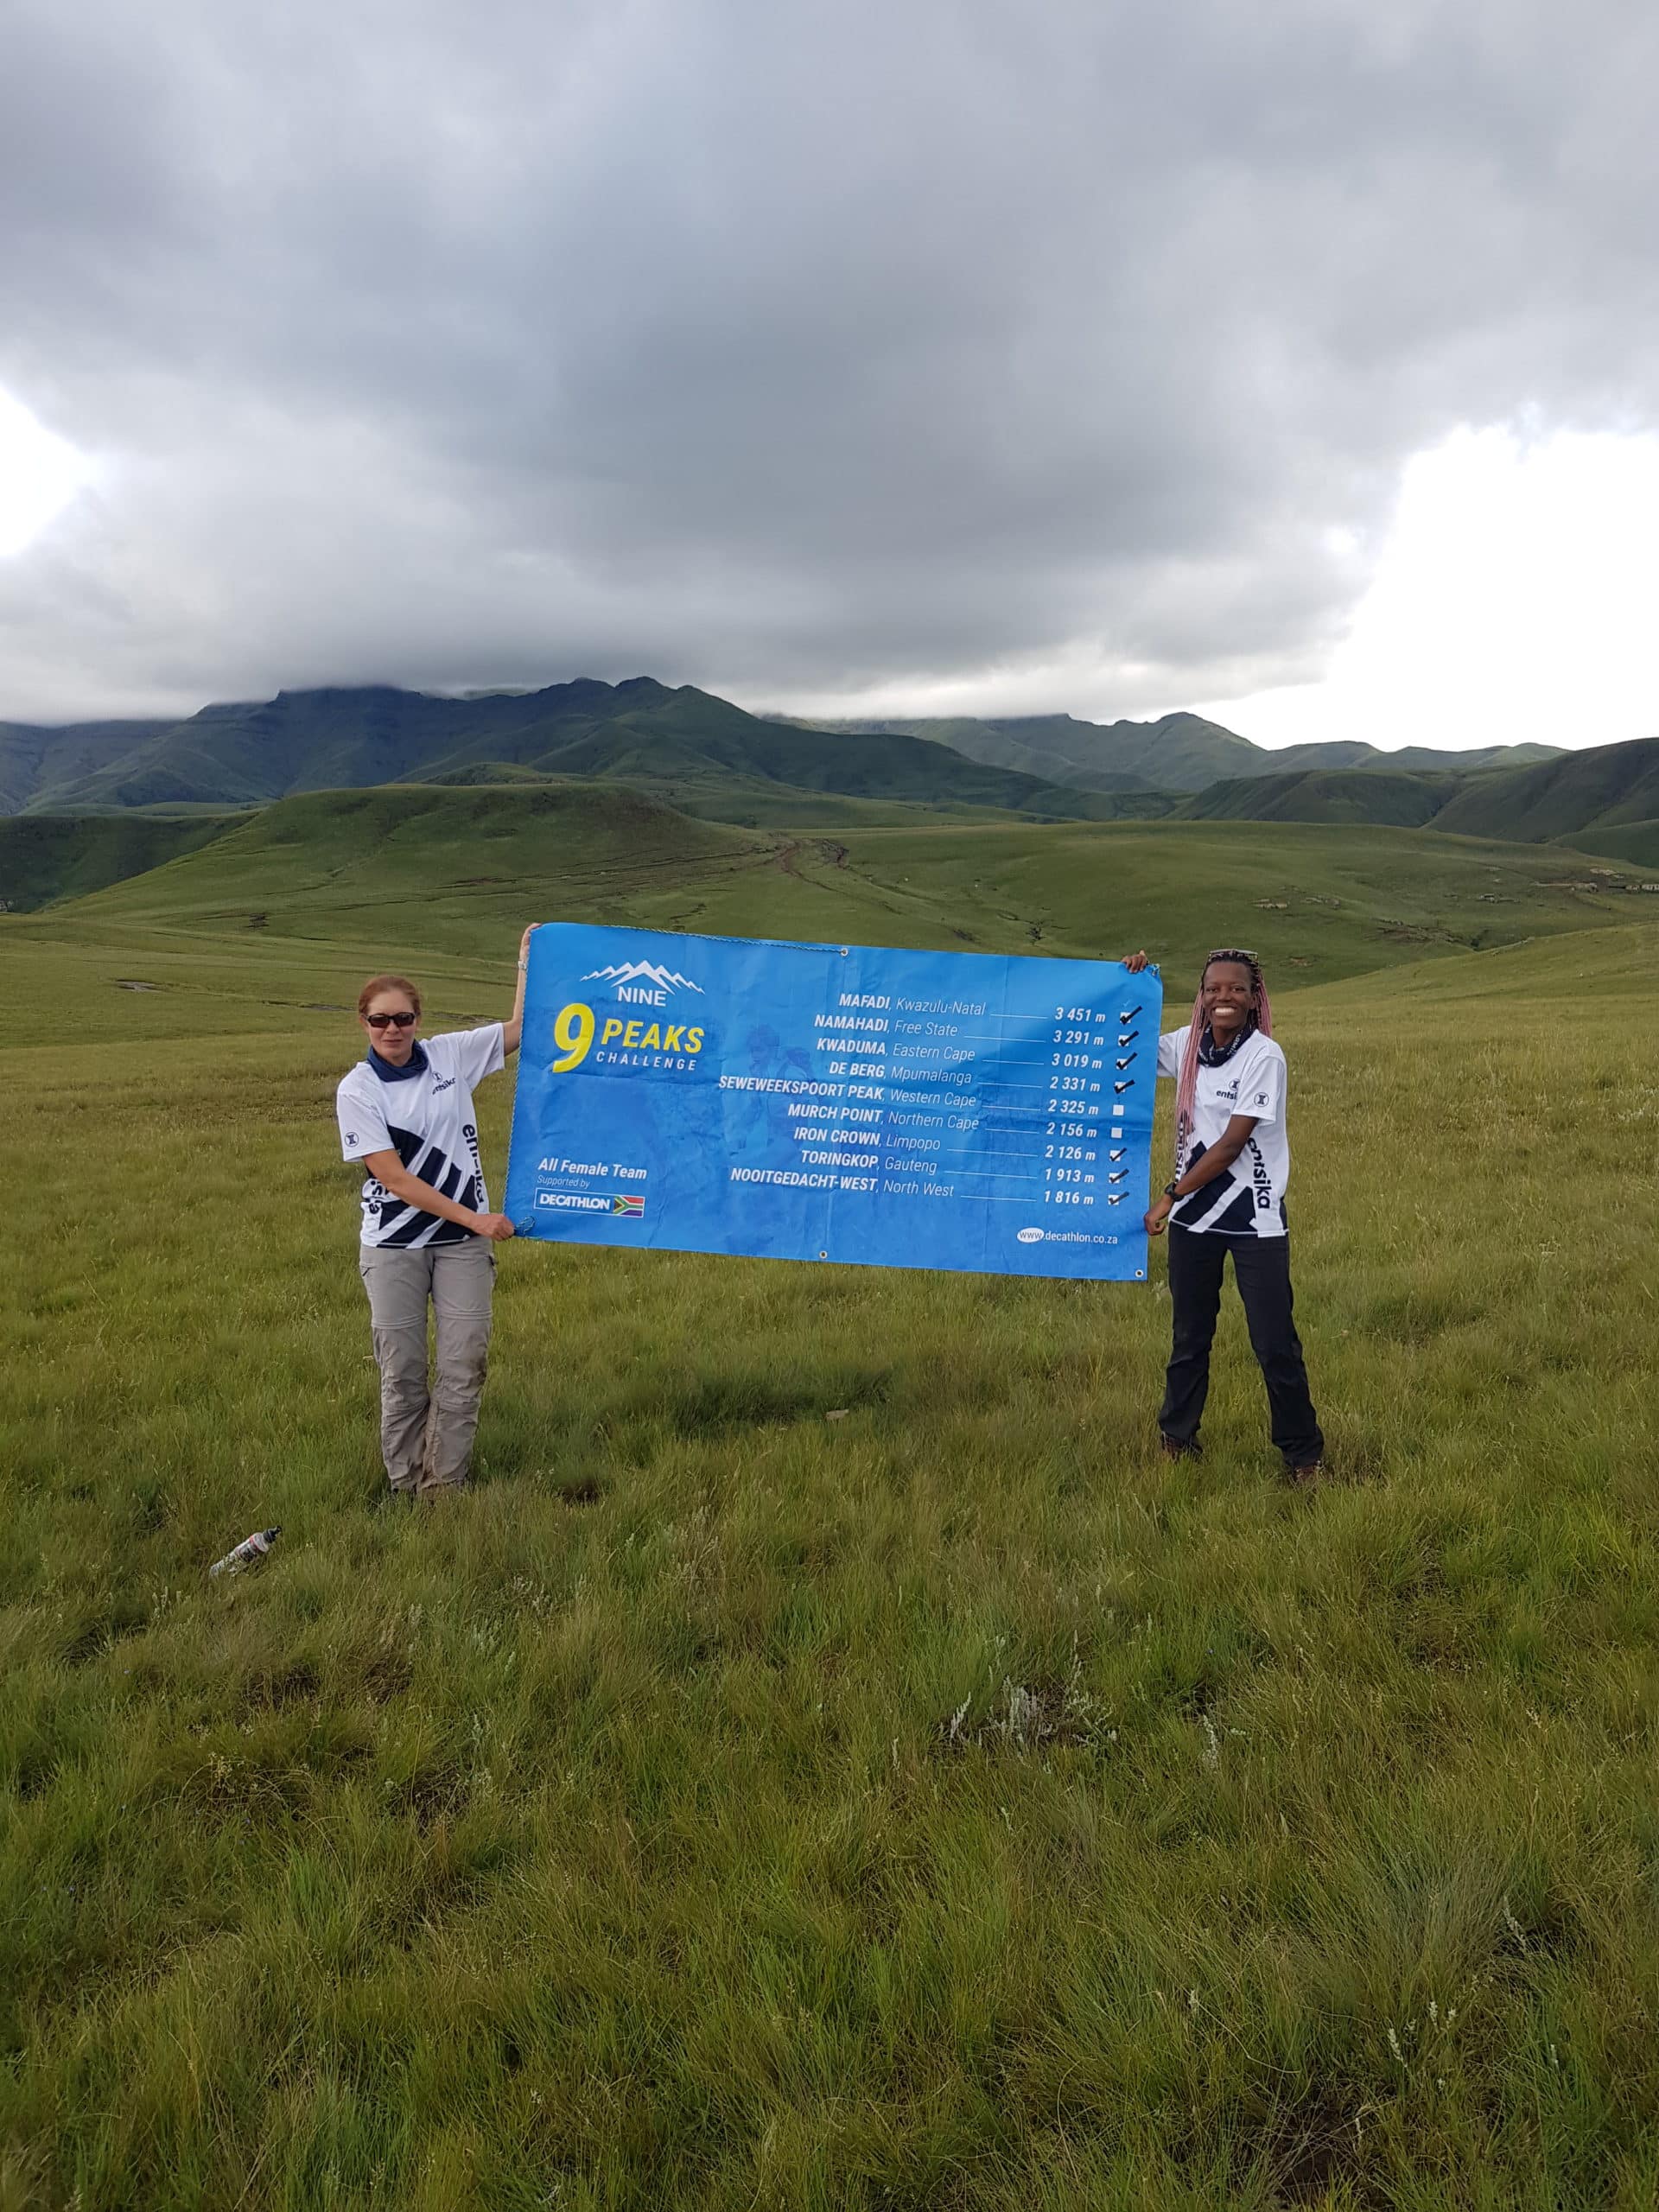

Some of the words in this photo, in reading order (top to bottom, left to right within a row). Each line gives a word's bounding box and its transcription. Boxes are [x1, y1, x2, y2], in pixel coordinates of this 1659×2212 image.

[617, 986, 667, 1007] NINE
[896, 997, 987, 1016] Kwazulu-Natal
[1054, 1007, 1064, 1020] 3
[1067, 1007, 1091, 1022] 451
[1095, 1014, 1106, 1023] m
[552, 1002, 595, 1073] 9
[601, 1018, 705, 1054] PEAKS
[894, 1020, 922, 1034] Free
[925, 1021, 958, 1037] State
[1052, 1029, 1062, 1043] 3
[1065, 1030, 1090, 1045] 291
[1093, 1036, 1104, 1046] m
[595, 1051, 697, 1071] CHALLENGE
[893, 1043, 940, 1059] Eastern
[944, 1046, 976, 1064] Cape
[1051, 1052, 1061, 1066] 3
[1064, 1053, 1089, 1068] 019
[1091, 1059, 1103, 1069] m
[829, 1061, 848, 1075] DE
[891, 1065, 973, 1086] Mpumalanga
[718, 1075, 846, 1097] SEWEWEEKSPOORT
[890, 1089, 941, 1104] Western
[944, 1091, 977, 1109] Cape
[1049, 1076, 1059, 1090] 2
[1061, 1077, 1087, 1091] 331
[1090, 1083, 1101, 1092] m
[1047, 1098, 1058, 1113] 2
[1060, 1100, 1086, 1115] 325
[1088, 1106, 1099, 1116] m
[787, 1103, 838, 1120] MURCH
[888, 1110, 944, 1128] Northern
[947, 1115, 980, 1133] Cape
[793, 1126, 829, 1142] IRON
[886, 1133, 942, 1153] Limpopo
[1046, 1122, 1056, 1135] 2
[1059, 1123, 1084, 1137] 156
[1086, 1128, 1097, 1138] m
[1045, 1145, 1054, 1159] 2
[1058, 1146, 1082, 1160] 126
[1085, 1152, 1096, 1161] m
[537, 1157, 559, 1172] All
[560, 1159, 609, 1176] Female
[612, 1163, 648, 1180] Team
[884, 1156, 938, 1176] Gauteng
[1045, 1167, 1052, 1181] 1
[1057, 1168, 1082, 1183] 913
[1084, 1174, 1095, 1184] m
[1247, 1137, 1273, 1209] entsika
[537, 1174, 579, 1187] Supported
[580, 1178, 590, 1190] by
[883, 1179, 919, 1195] North
[923, 1181, 955, 1198] West
[539, 1192, 611, 1211] DECATHLON
[1044, 1190, 1052, 1203] 1
[1055, 1191, 1080, 1205] 816
[1083, 1197, 1094, 1205] m
[1018, 1230, 1119, 1245] www.decathlon.co.za
